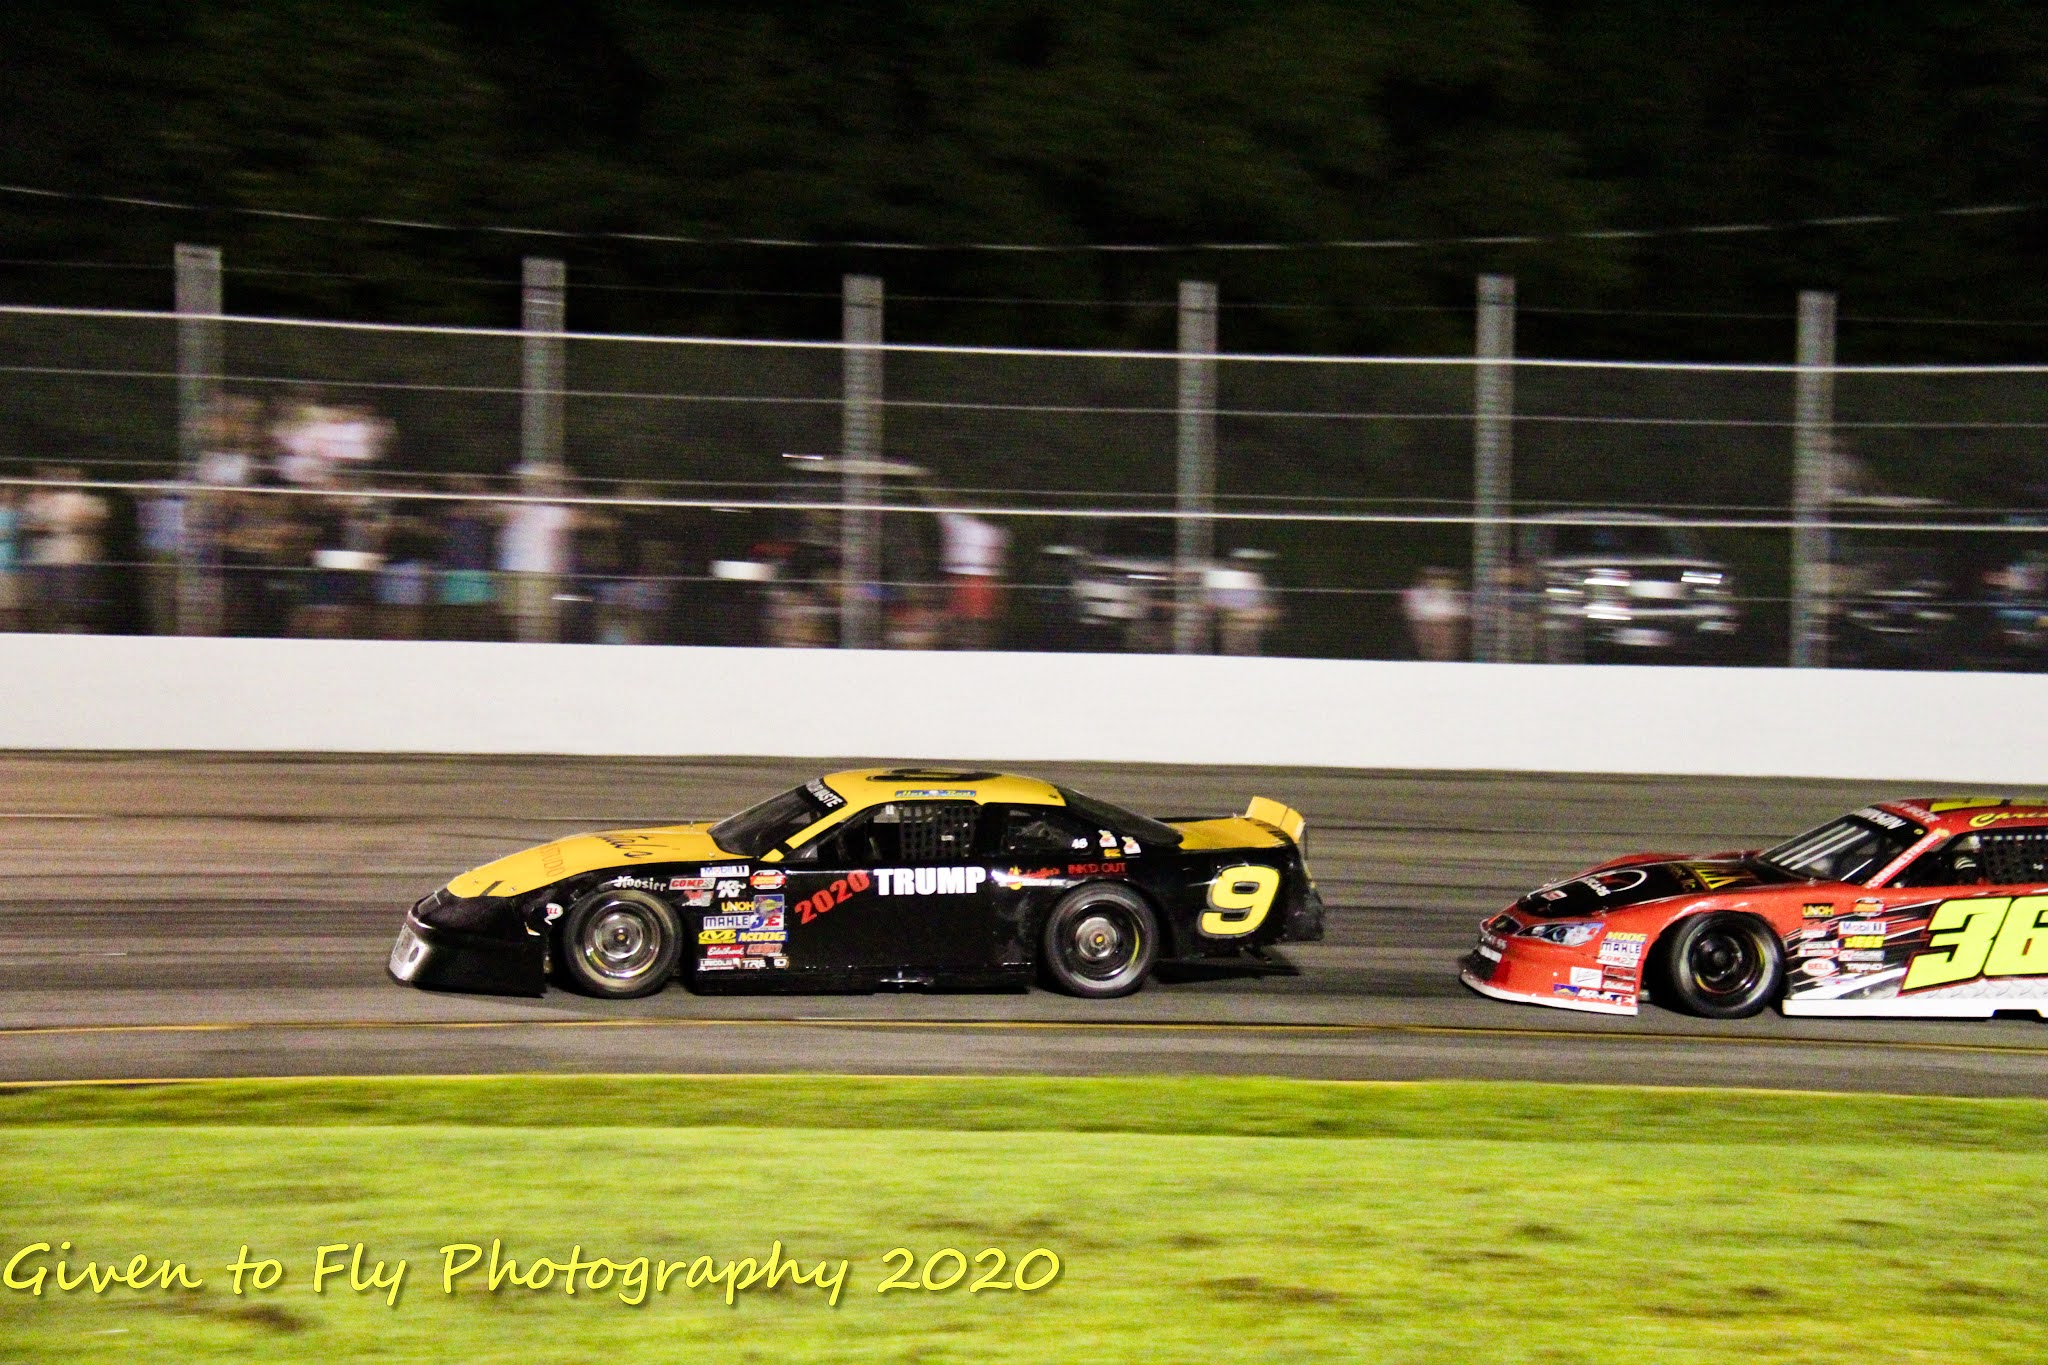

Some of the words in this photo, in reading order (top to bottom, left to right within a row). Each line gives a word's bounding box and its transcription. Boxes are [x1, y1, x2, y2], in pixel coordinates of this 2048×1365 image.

[1101, 862, 1126, 873] OUT
[613, 875, 667, 892] Hoosier
[794, 870, 871, 925] 2020
[873, 867, 986, 896] TRUMP
[1198, 864, 1281, 938] 9
[721, 901, 755, 912] UNOH
[1803, 904, 1834, 916] UNOH
[705, 916, 749, 927] MAHLE
[738, 931, 787, 942] MOOG
[1606, 931, 1648, 943] MOOG
[1602, 942, 1640, 954] MAHLE
[1900, 895, 2048, 991] 36
